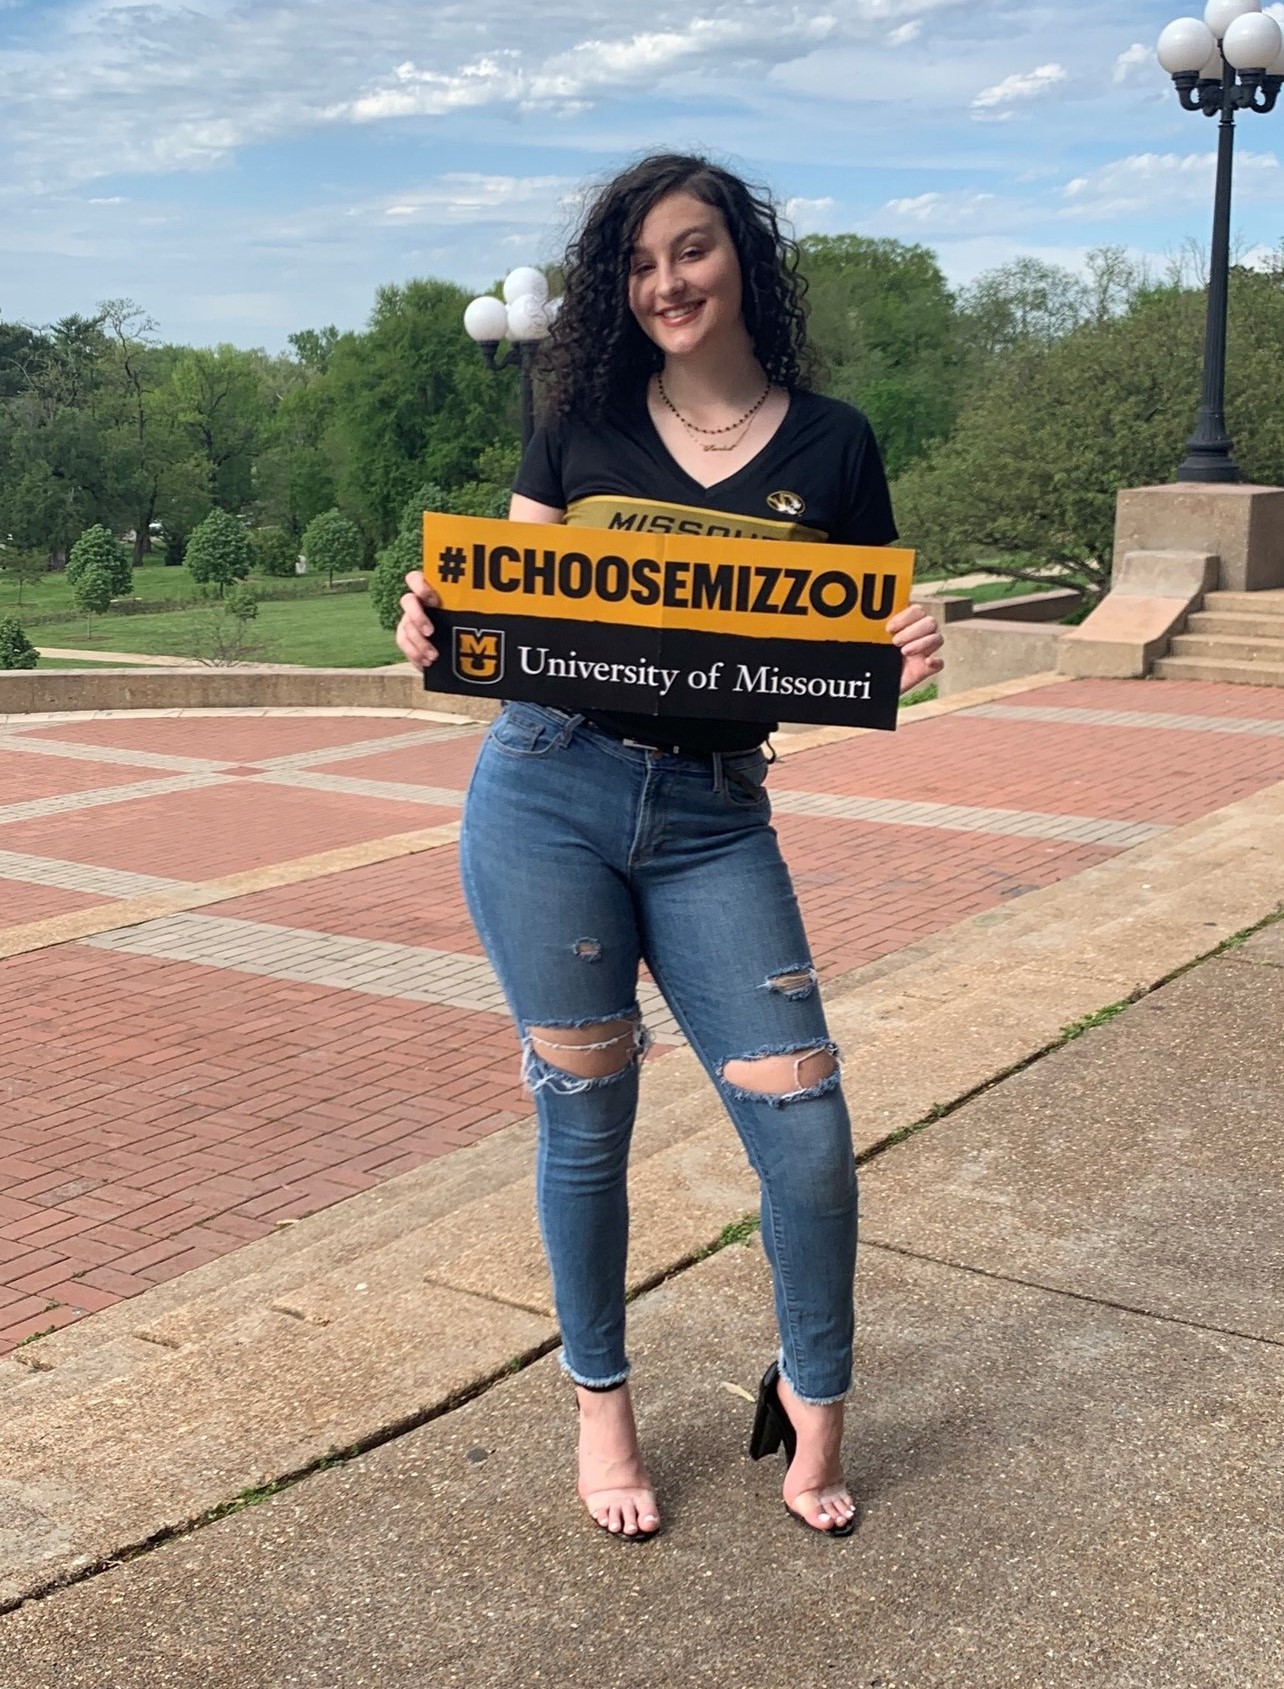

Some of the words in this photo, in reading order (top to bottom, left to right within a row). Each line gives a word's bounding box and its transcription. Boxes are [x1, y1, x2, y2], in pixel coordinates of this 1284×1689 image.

[607, 511, 786, 541] MISSO
[439, 544, 897, 620] #ICHOOSEMIZZOU
[517, 645, 679, 695] University
[687, 661, 724, 691] of
[732, 664, 872, 700] Missouri
